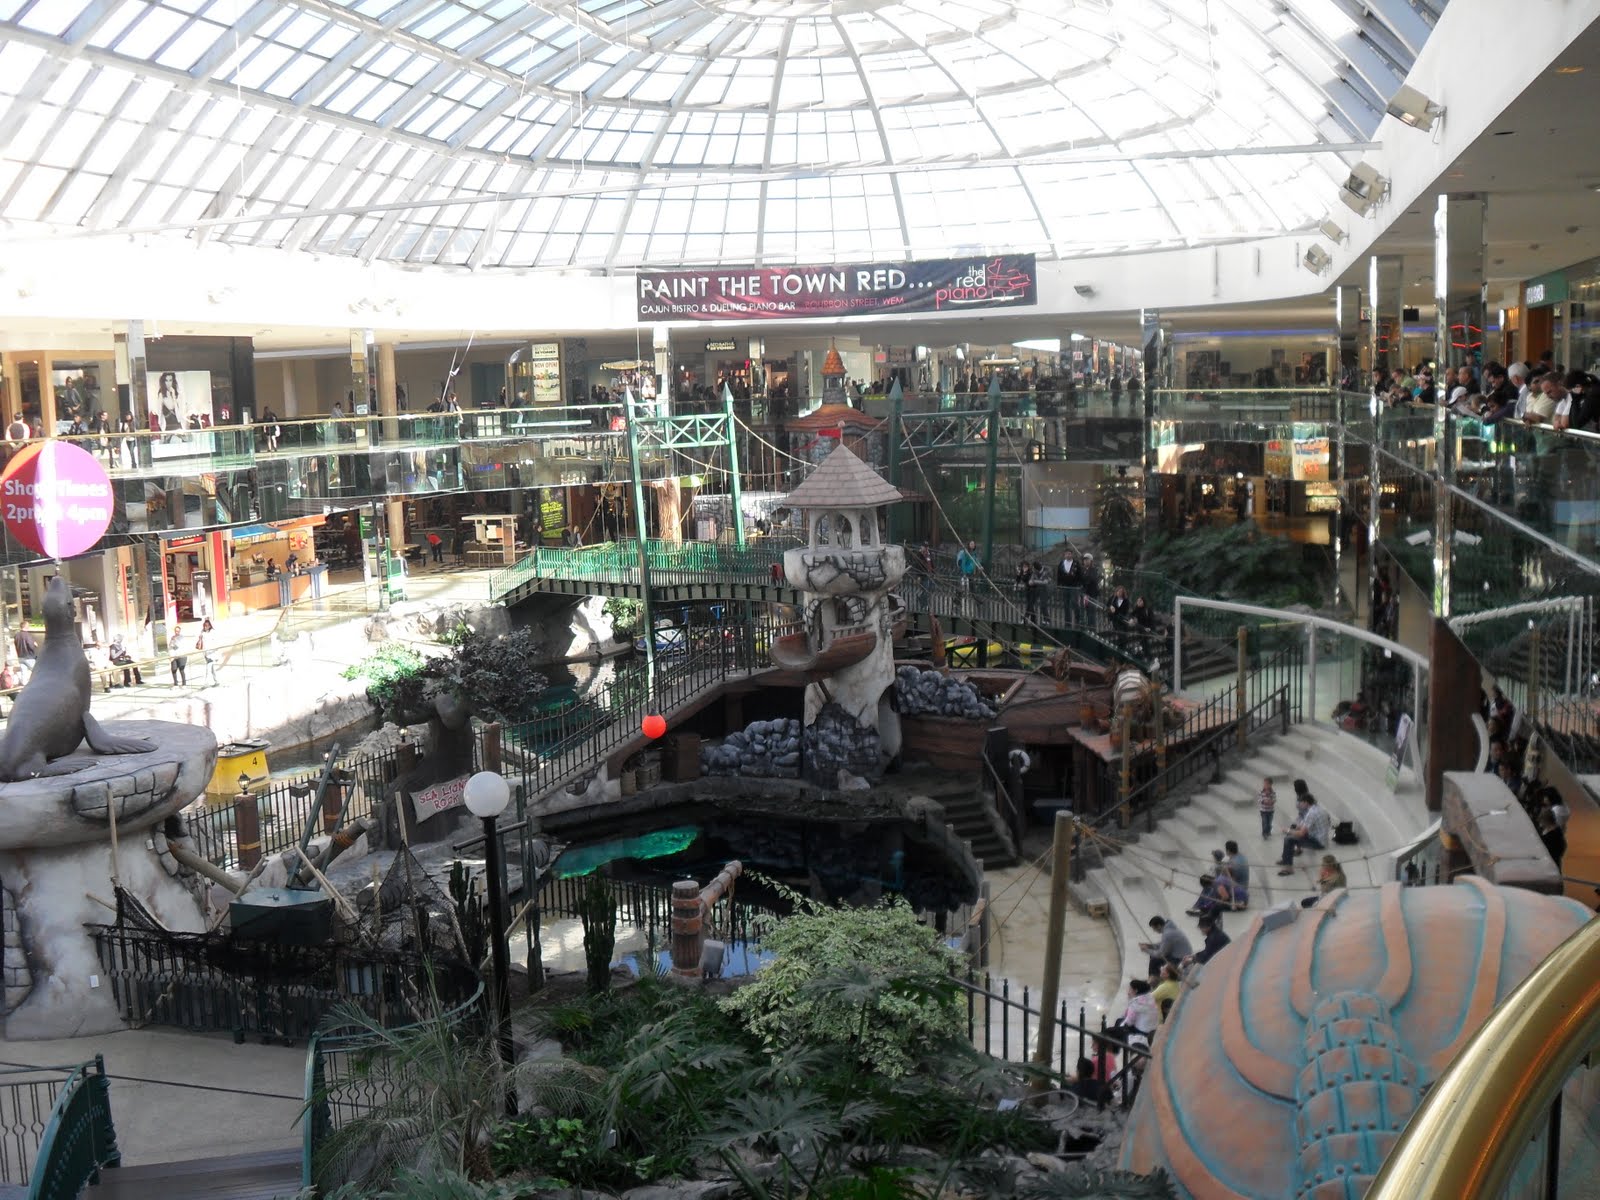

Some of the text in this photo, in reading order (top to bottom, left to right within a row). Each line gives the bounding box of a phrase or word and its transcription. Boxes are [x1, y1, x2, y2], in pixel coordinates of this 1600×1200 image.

[956, 264, 986, 288] red
[968, 265, 984, 277] the
[640, 268, 933, 299] PAINT THE TOWN RED...
[804, 298, 850, 310] BOURBON
[882, 295, 905, 306] WEM
[935, 283, 988, 310] piano
[640, 303, 670, 314] CAJUN
[671, 302, 700, 313] BISTRO
[701, 302, 709, 313] &
[749, 301, 777, 312] PIANO
[778, 301, 796, 311] BAR
[252, 756, 258, 766] 4
[418, 788, 438, 806] SEA
[433, 793, 460, 810] ROCK
